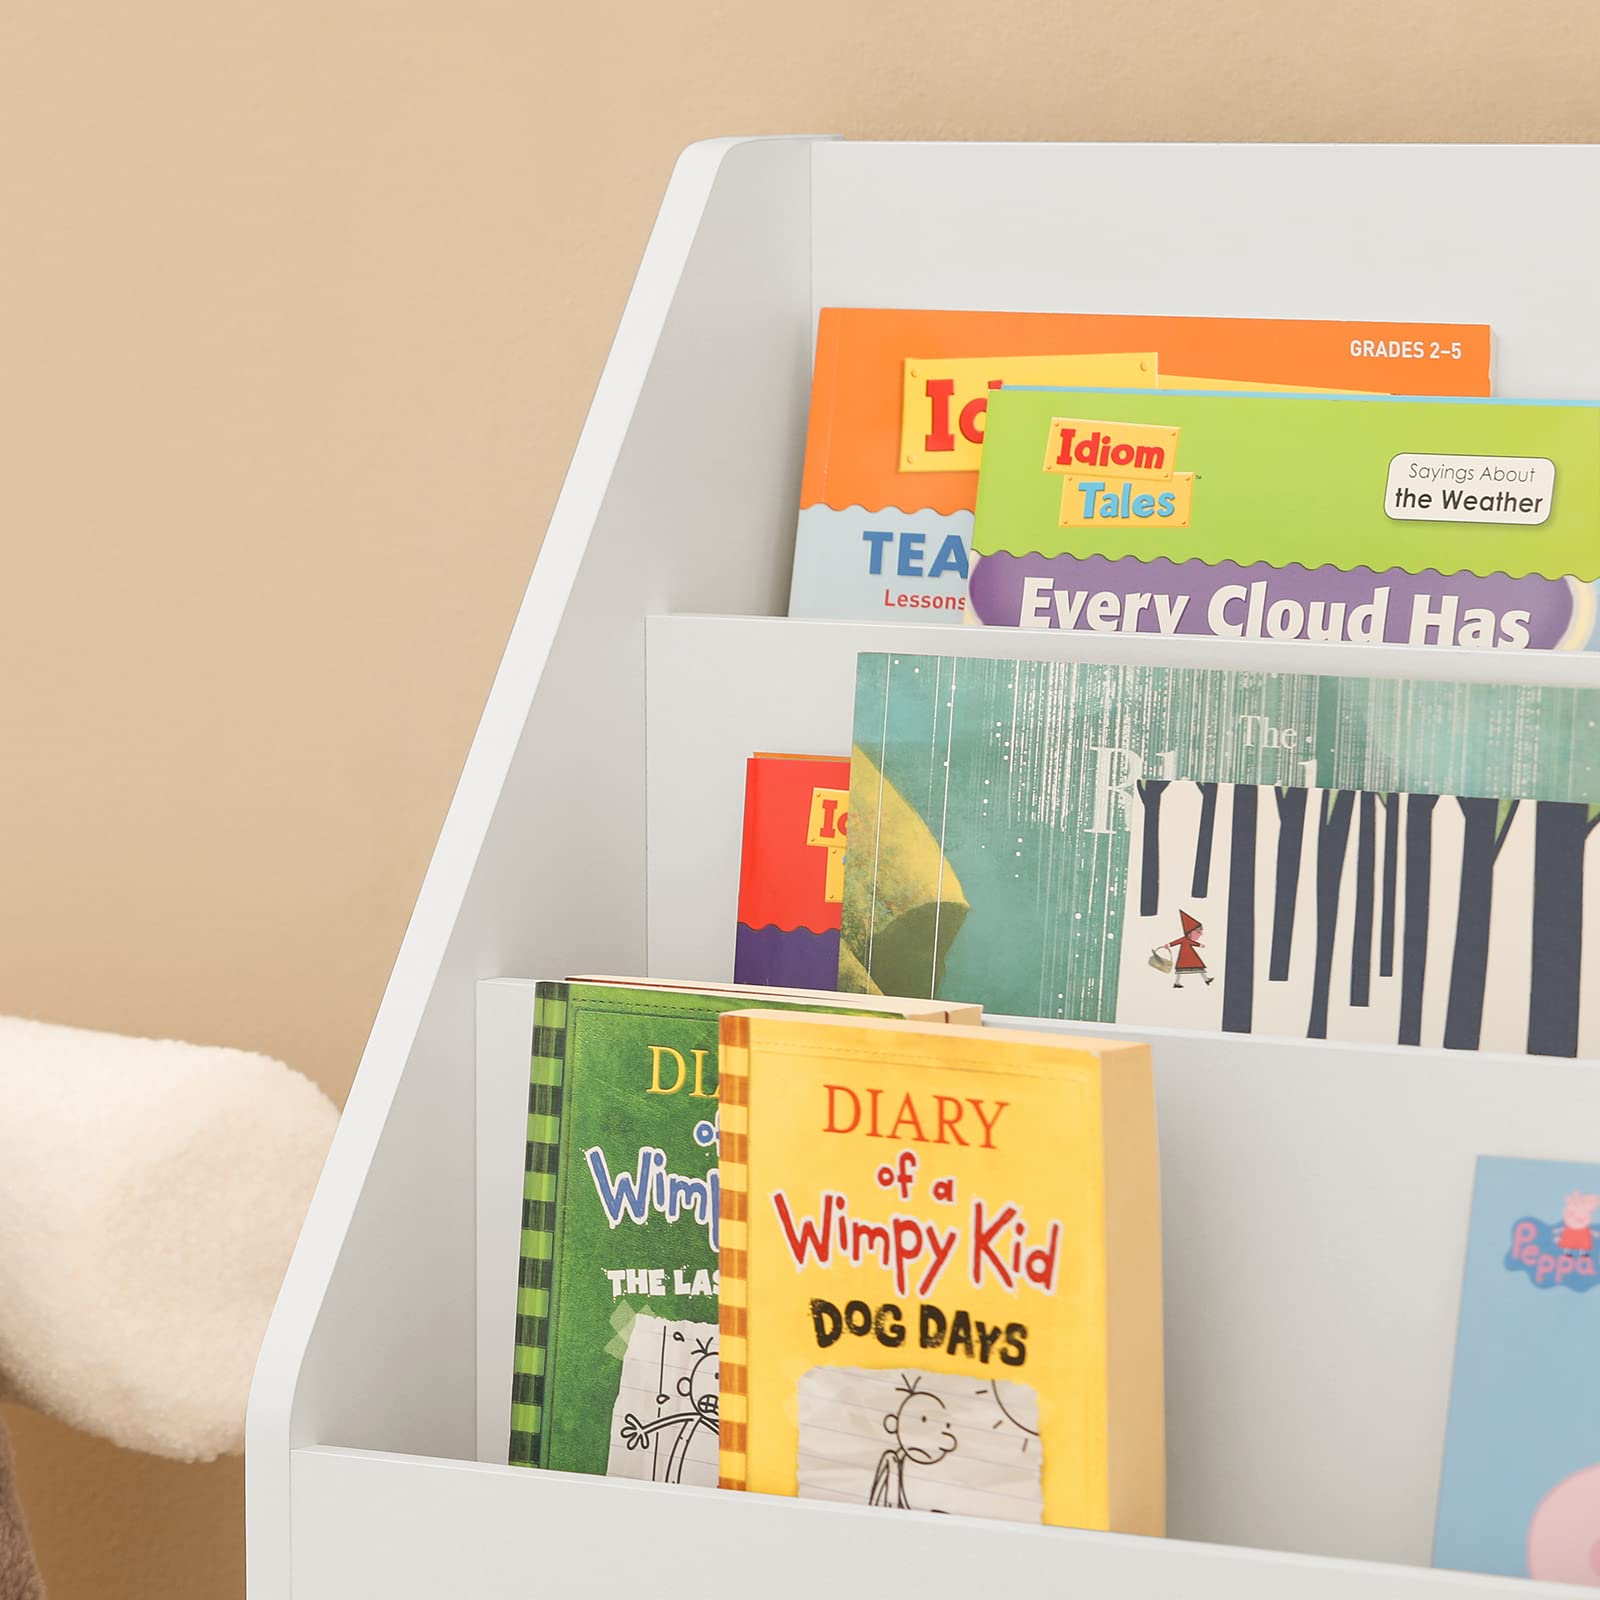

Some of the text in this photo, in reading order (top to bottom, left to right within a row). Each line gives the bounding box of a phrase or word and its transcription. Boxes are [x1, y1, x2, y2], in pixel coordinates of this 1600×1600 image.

[1350, 340, 1424, 359] GRADES
[1056, 428, 1166, 470] Idiom
[1408, 463, 1536, 484] Sayings About
[1078, 482, 1176, 519] Tales
[1395, 488, 1543, 513] the Weather
[863, 530, 969, 580] TEA
[1019, 576, 1532, 649] Every Cloud Has
[1241, 715, 1297, 749] The
[646, 1045, 720, 1098] DI
[695, 1112, 720, 1156] o
[823, 1084, 1011, 1150] DIARY
[876, 1151, 954, 1202] of a
[772, 1191, 1060, 1297] Wimpy Kid
[1512, 1221, 1597, 1284] Peppa
[607, 1269, 666, 1297] THE
[810, 1298, 1028, 1367] DOG DAYS
